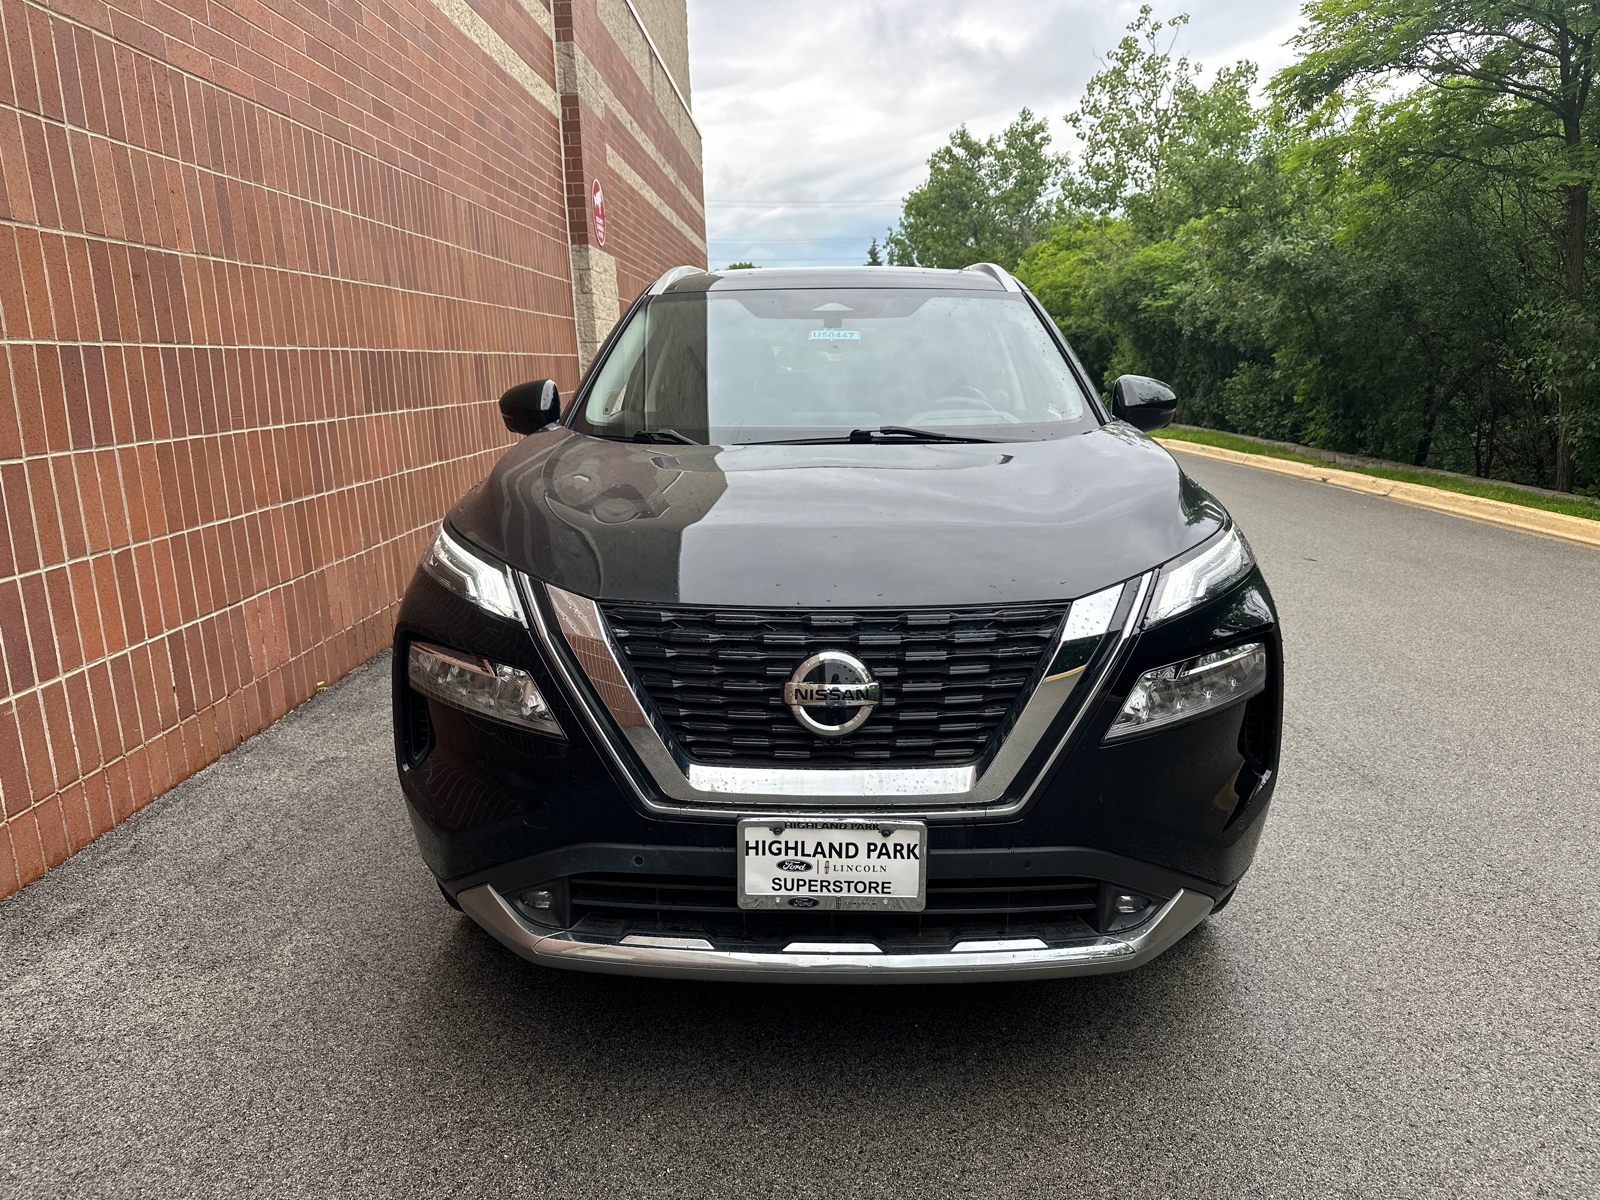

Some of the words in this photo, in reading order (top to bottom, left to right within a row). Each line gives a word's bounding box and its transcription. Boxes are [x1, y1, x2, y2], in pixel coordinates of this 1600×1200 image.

[813, 331, 855, 339] U50447
[794, 688, 869, 701] NISSAN
[784, 821, 848, 831] HIGHLAND
[851, 822, 880, 831] PARK
[745, 840, 860, 859] HIGHLAND
[866, 842, 920, 860] PARK
[832, 864, 888, 873] LINCOLN
[771, 877, 892, 895] SUPERSTORE
